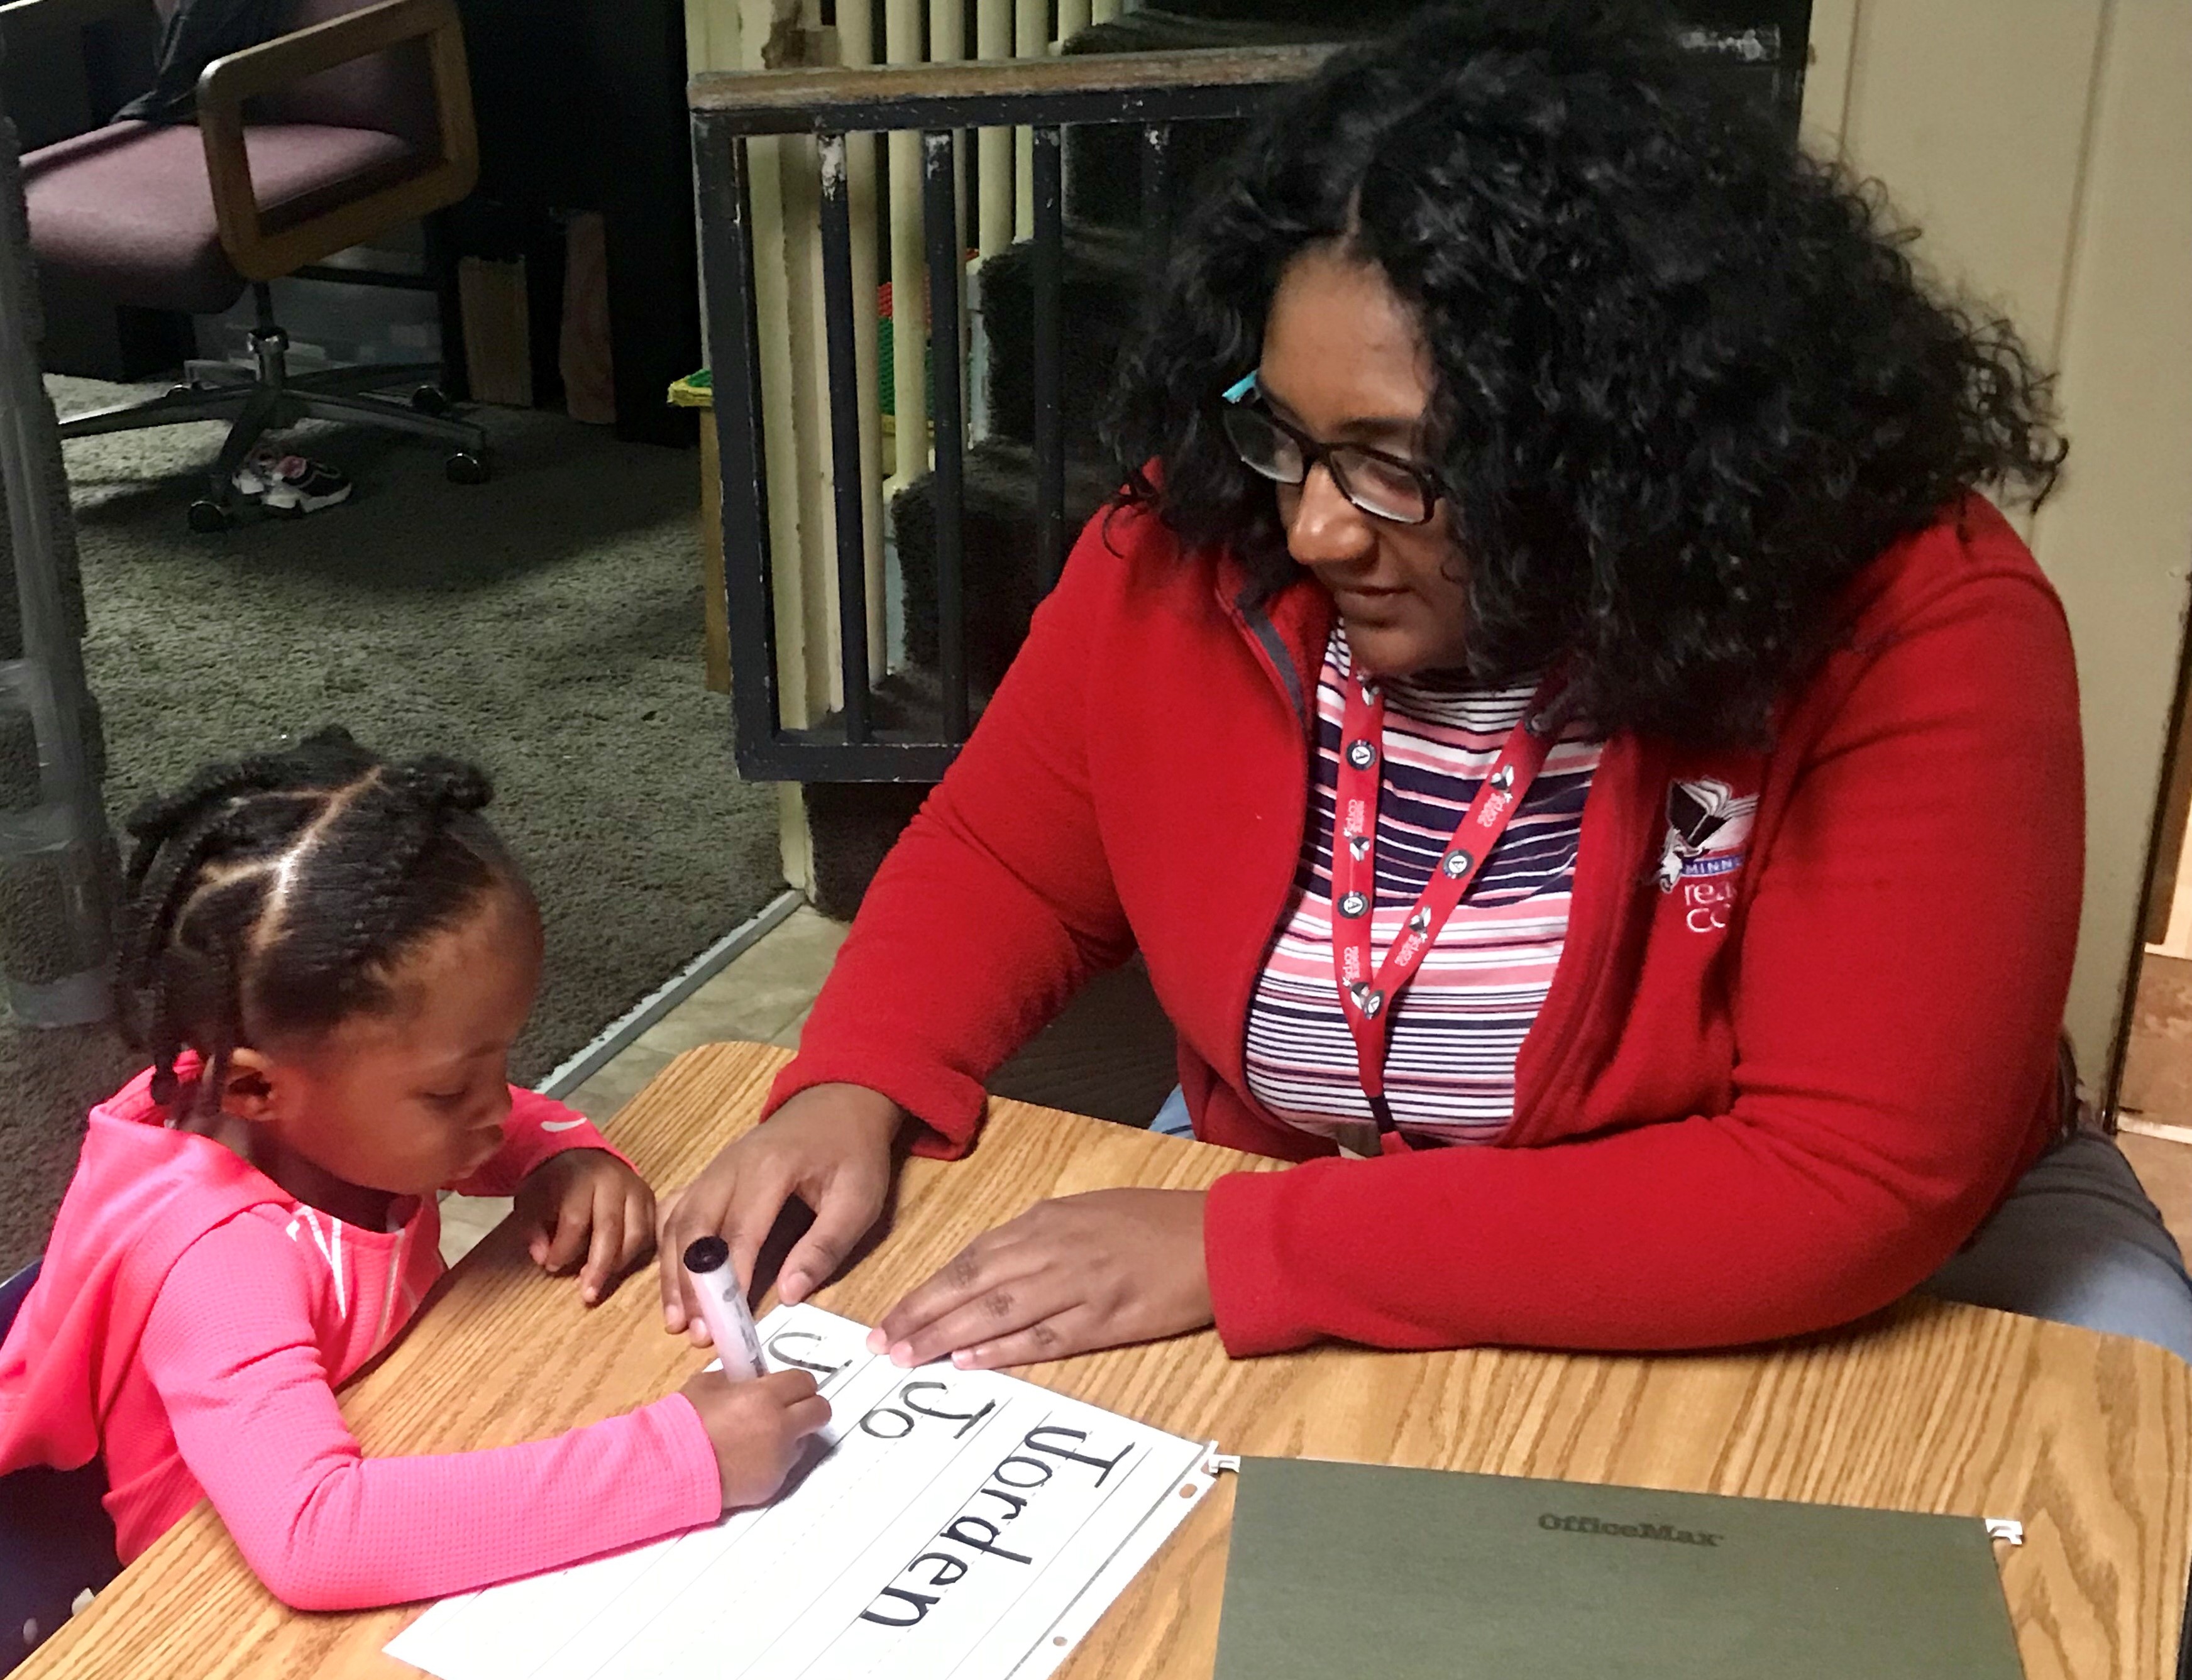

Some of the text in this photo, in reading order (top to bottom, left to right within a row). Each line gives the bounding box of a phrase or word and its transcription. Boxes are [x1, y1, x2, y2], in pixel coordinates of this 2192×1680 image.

[859, 1381, 996, 1439] Jo
[859, 1425, 1136, 1627] Jorden
[1538, 1513, 1721, 1547] OfficeMax
